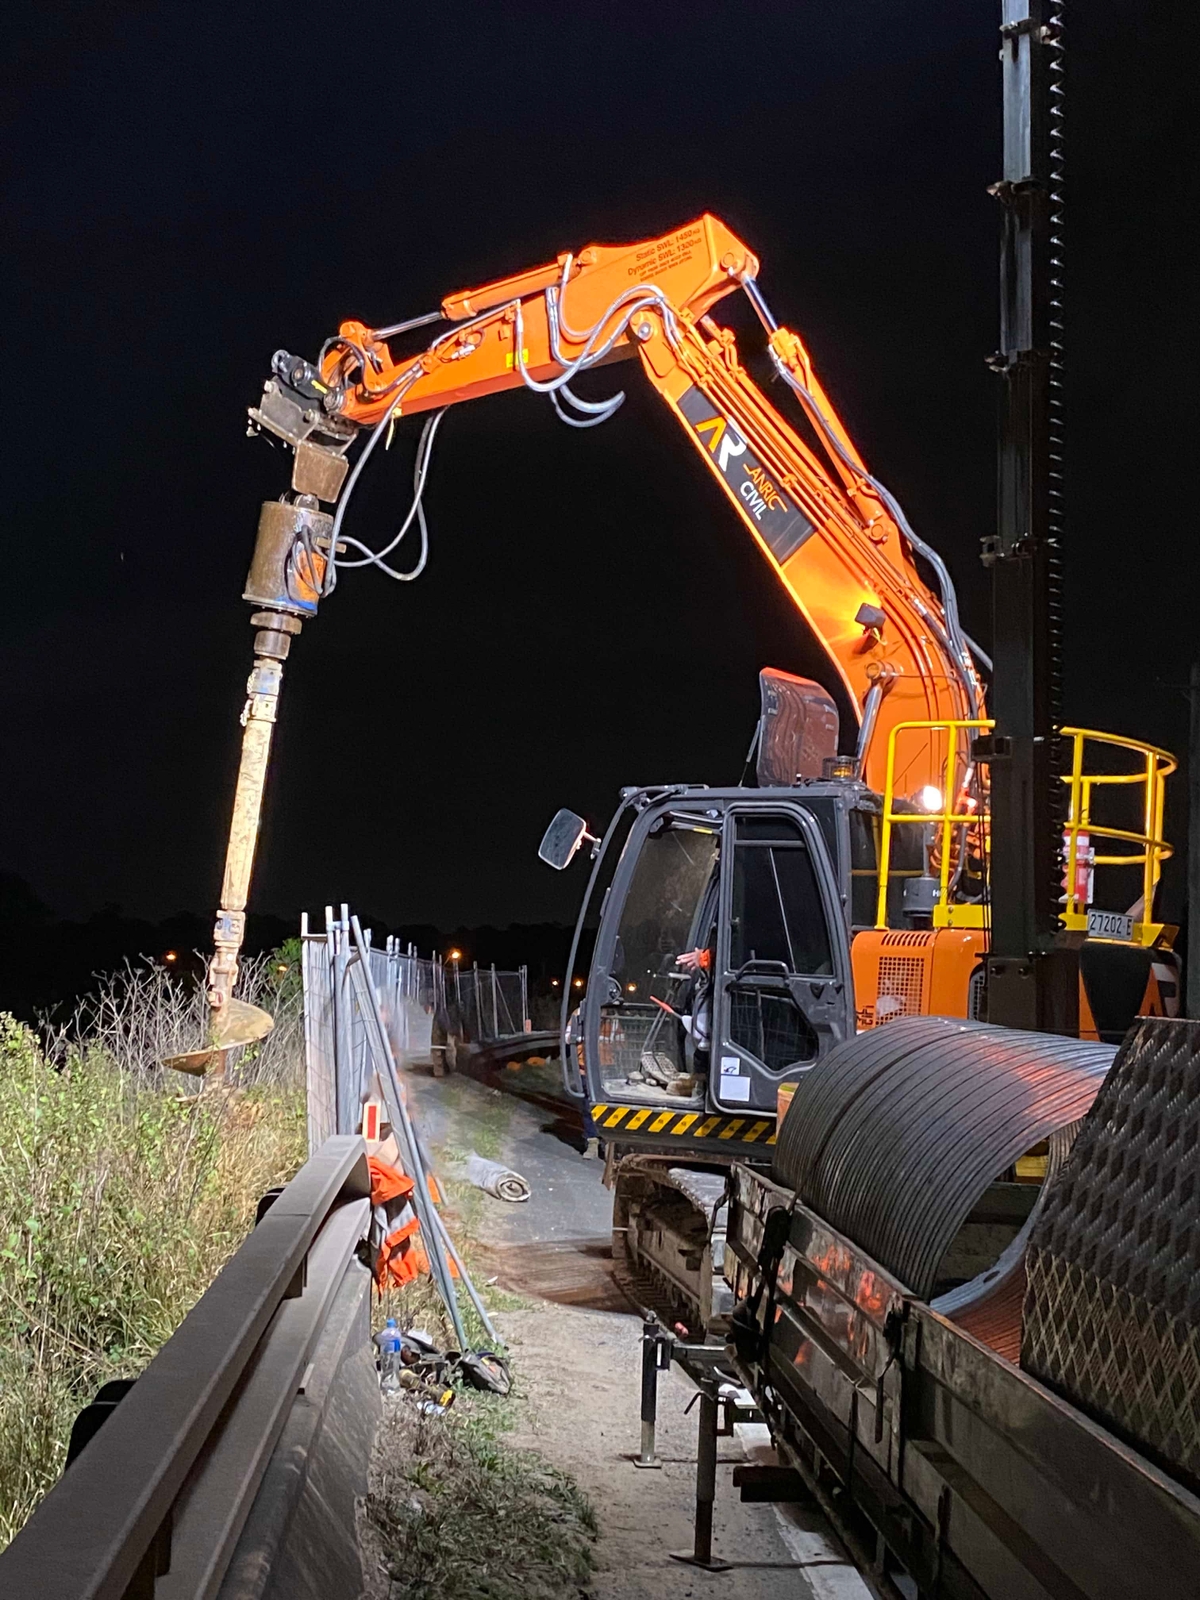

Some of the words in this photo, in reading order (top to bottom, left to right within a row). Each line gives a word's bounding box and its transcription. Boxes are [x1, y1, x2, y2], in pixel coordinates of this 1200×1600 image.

[628, 258, 656, 275] Dynamic
[636, 248, 655, 261] Static
[740, 481, 767, 520] CIVIL
[743, 463, 788, 513] ANRIC
